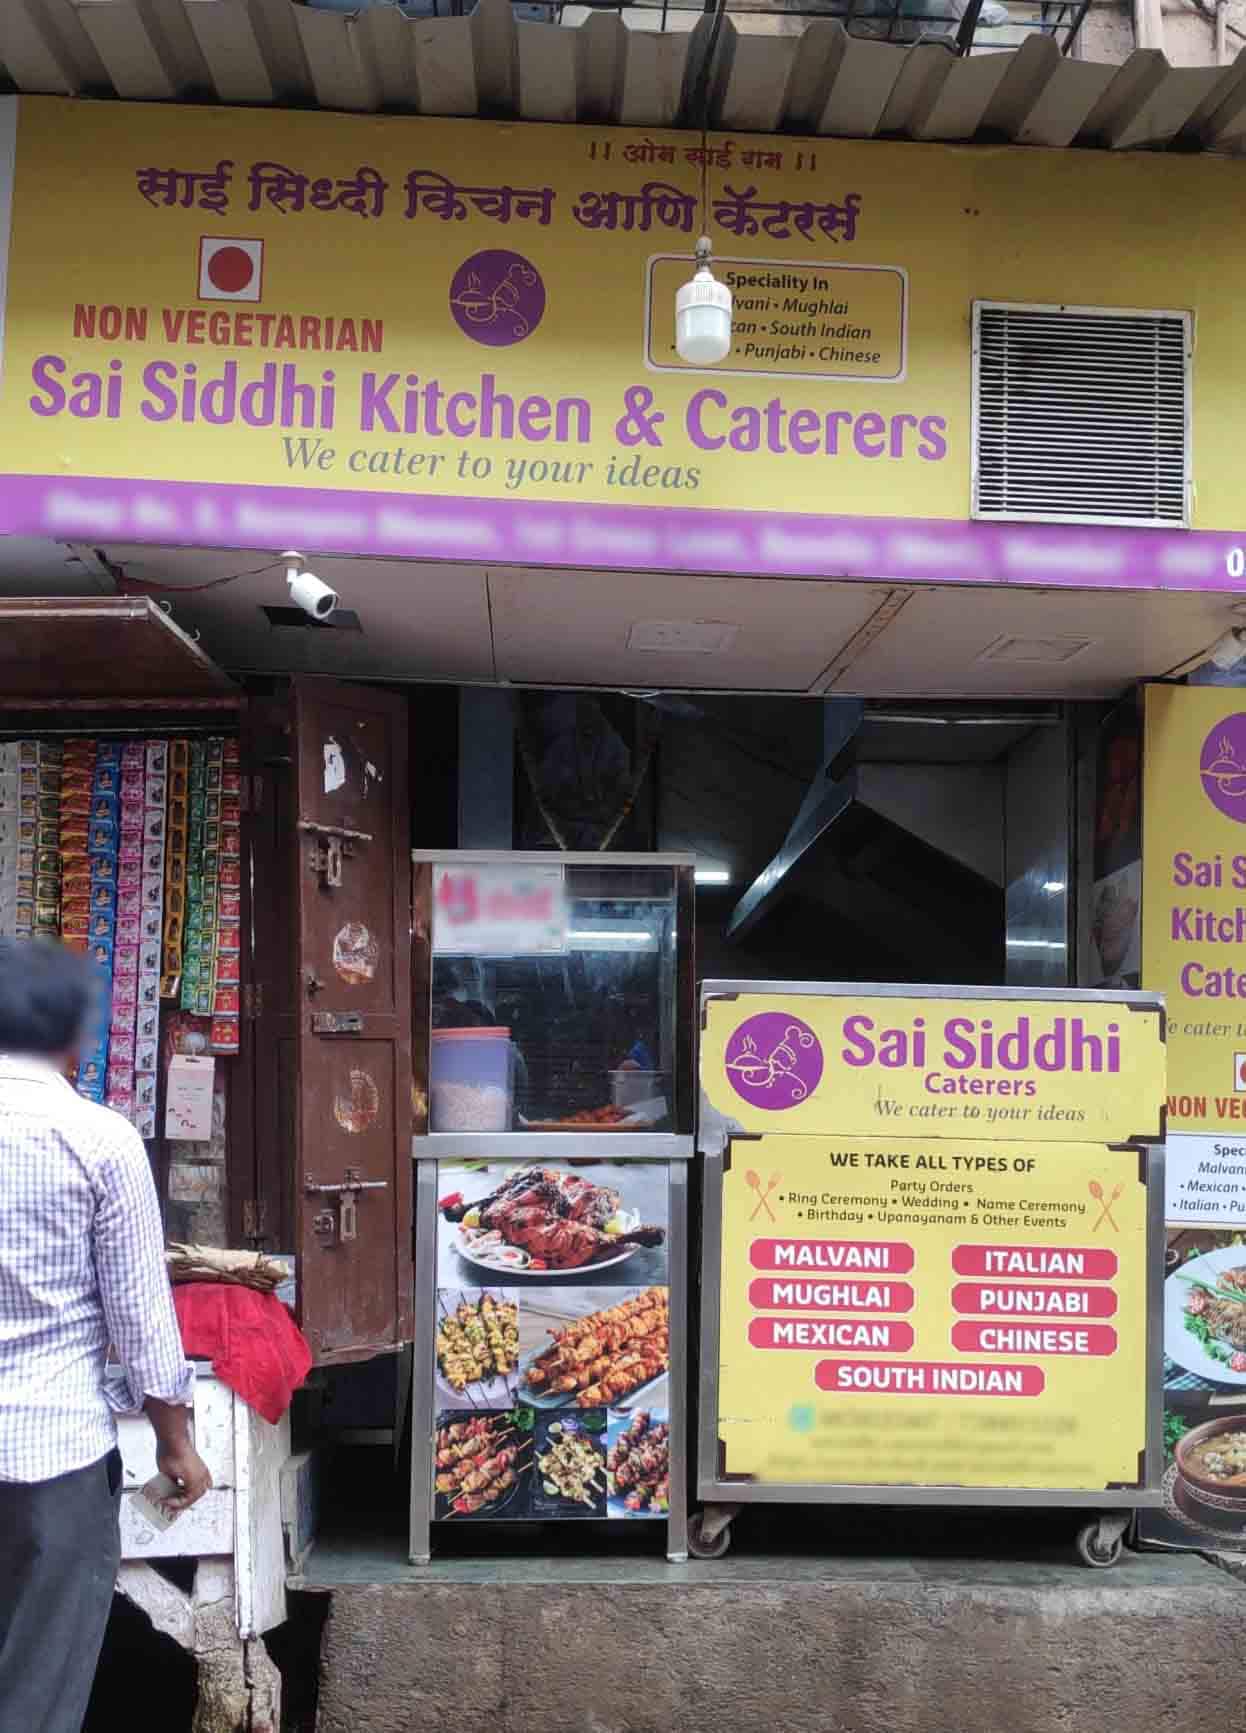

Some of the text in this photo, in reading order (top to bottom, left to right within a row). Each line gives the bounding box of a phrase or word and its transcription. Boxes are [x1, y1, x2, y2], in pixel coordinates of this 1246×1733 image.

[136, 160, 233, 216] साई
[404, 170, 556, 225] किचन
[572, 182, 697, 232] आणि
[726, 271, 829, 293] Speciality In
[783, 297, 849, 317] Mughlai
[73, 303, 384, 353] NON VEGETARIAN
[769, 319, 816, 337] South
[821, 322, 871, 340] Indian
[744, 343, 881, 364] Punjabi Chinese
[29, 355, 948, 461] Sai Siddhi Kitchen & Caterers
[282, 437, 701, 489] We cater to your ideas
[1173, 852, 1222, 888] Sai
[1184, 1020, 1231, 1036] cater
[842, 1015, 1120, 1072] Sai Siddhi
[924, 1072, 1037, 1096] Caterers
[875, 1100, 1086, 1122] We cater to your ideas
[830, 1152, 1036, 1172] WE TAKE ALL TYPES OF
[890, 1180, 974, 1194] Party Orders
[1187, 1180, 1239, 1193] Mexican
[788, 1192, 1086, 1214] Ring Ceremony Wedding Name Ceremony
[1179, 1199, 1220, 1211] Italian
[807, 1209, 864, 1222] Birthday
[983, 1214, 1019, 1226] Other
[1023, 1215, 1067, 1228] Events
[774, 1246, 889, 1269] MALVANI
[985, 1251, 1084, 1274] ITALIAN
[772, 1284, 890, 1307] MUGHLAI
[980, 1289, 1088, 1313] PUNJABI
[773, 1323, 889, 1346] MEXICAN
[979, 1329, 1089, 1352] CHINESE
[837, 1366, 1022, 1392] SOUTH INDIAN
